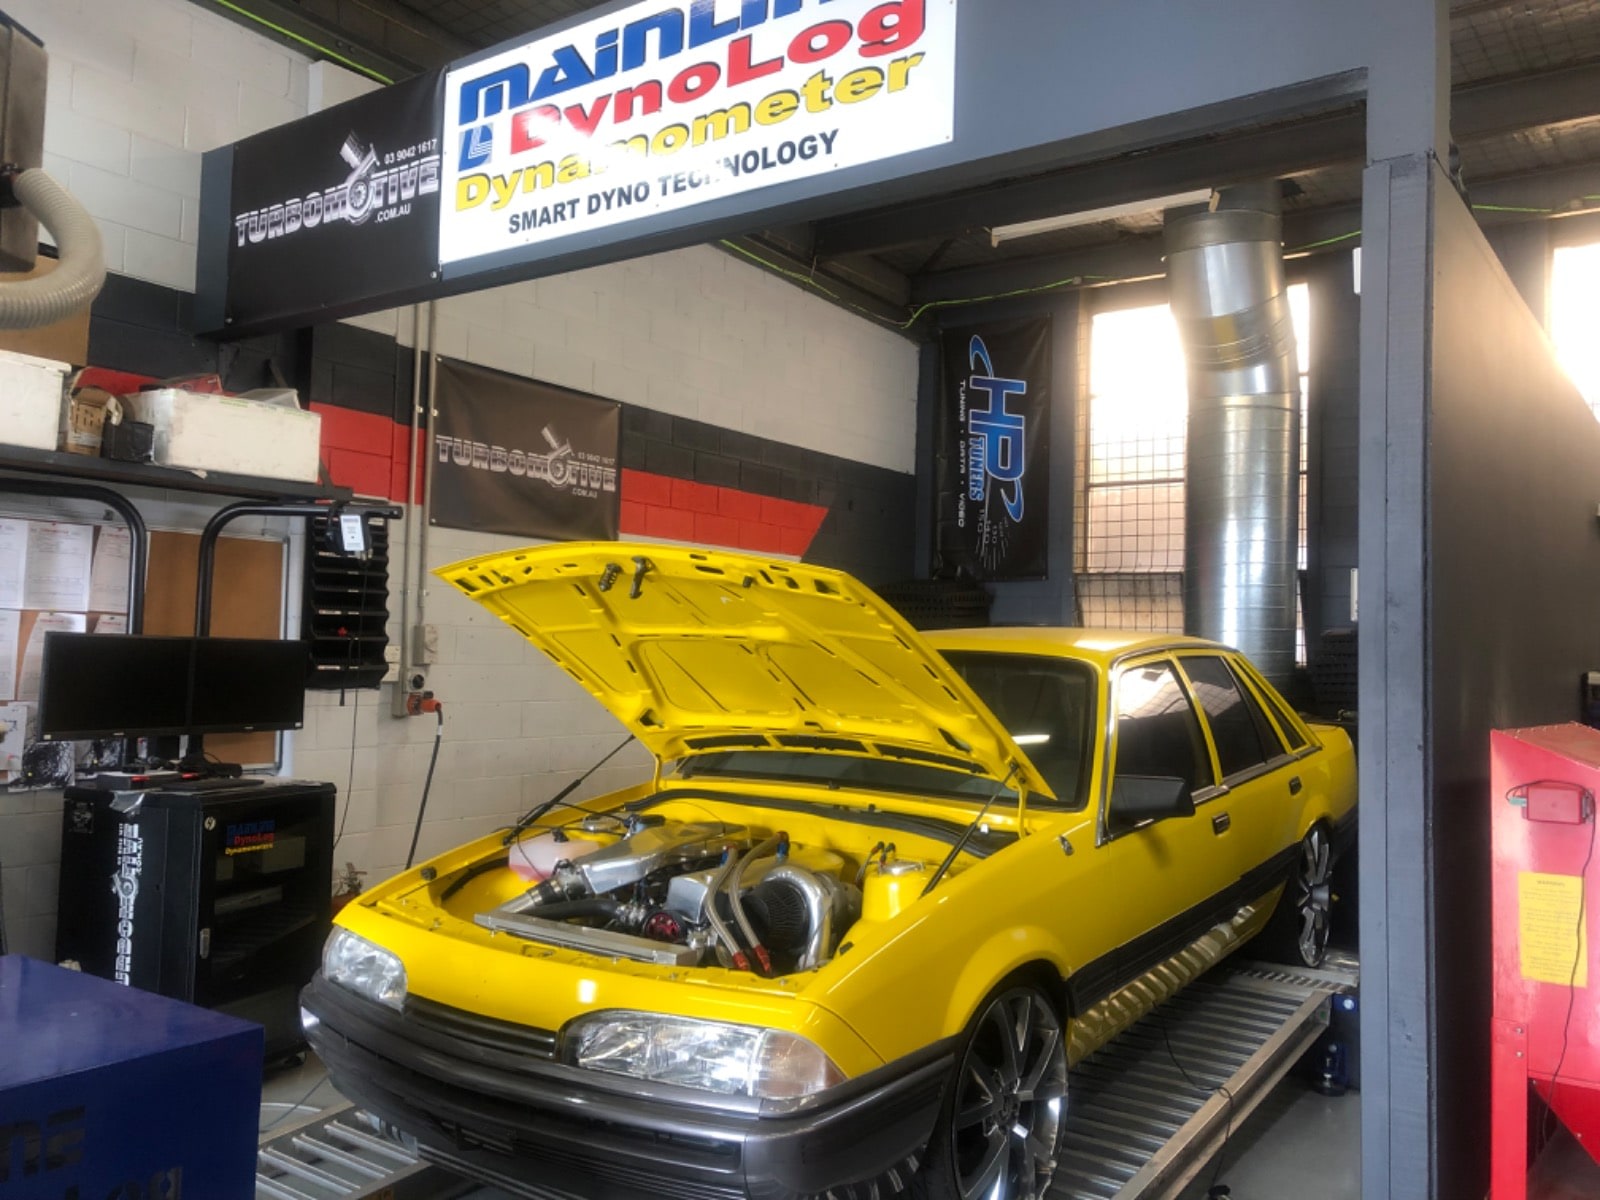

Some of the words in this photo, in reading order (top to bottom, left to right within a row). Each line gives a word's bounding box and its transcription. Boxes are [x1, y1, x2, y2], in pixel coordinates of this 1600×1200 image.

[511, 0, 926, 155] DynoLog
[384, 152, 395, 164] 03
[396, 146, 416, 161] 9042
[417, 139, 438, 153] 1617
[508, 197, 580, 234] SMART
[587, 181, 650, 216] DYNO
[658, 128, 839, 197] TECNOLOGY
[235, 155, 440, 247] TURBOMOTIVE
[959, 379, 967, 422] TUNING
[969, 375, 1027, 481] HP
[436, 434, 617, 493] TURBOMOTIVE
[969, 437, 985, 501] TUNERS
[958, 493, 966, 528] VIDEO
